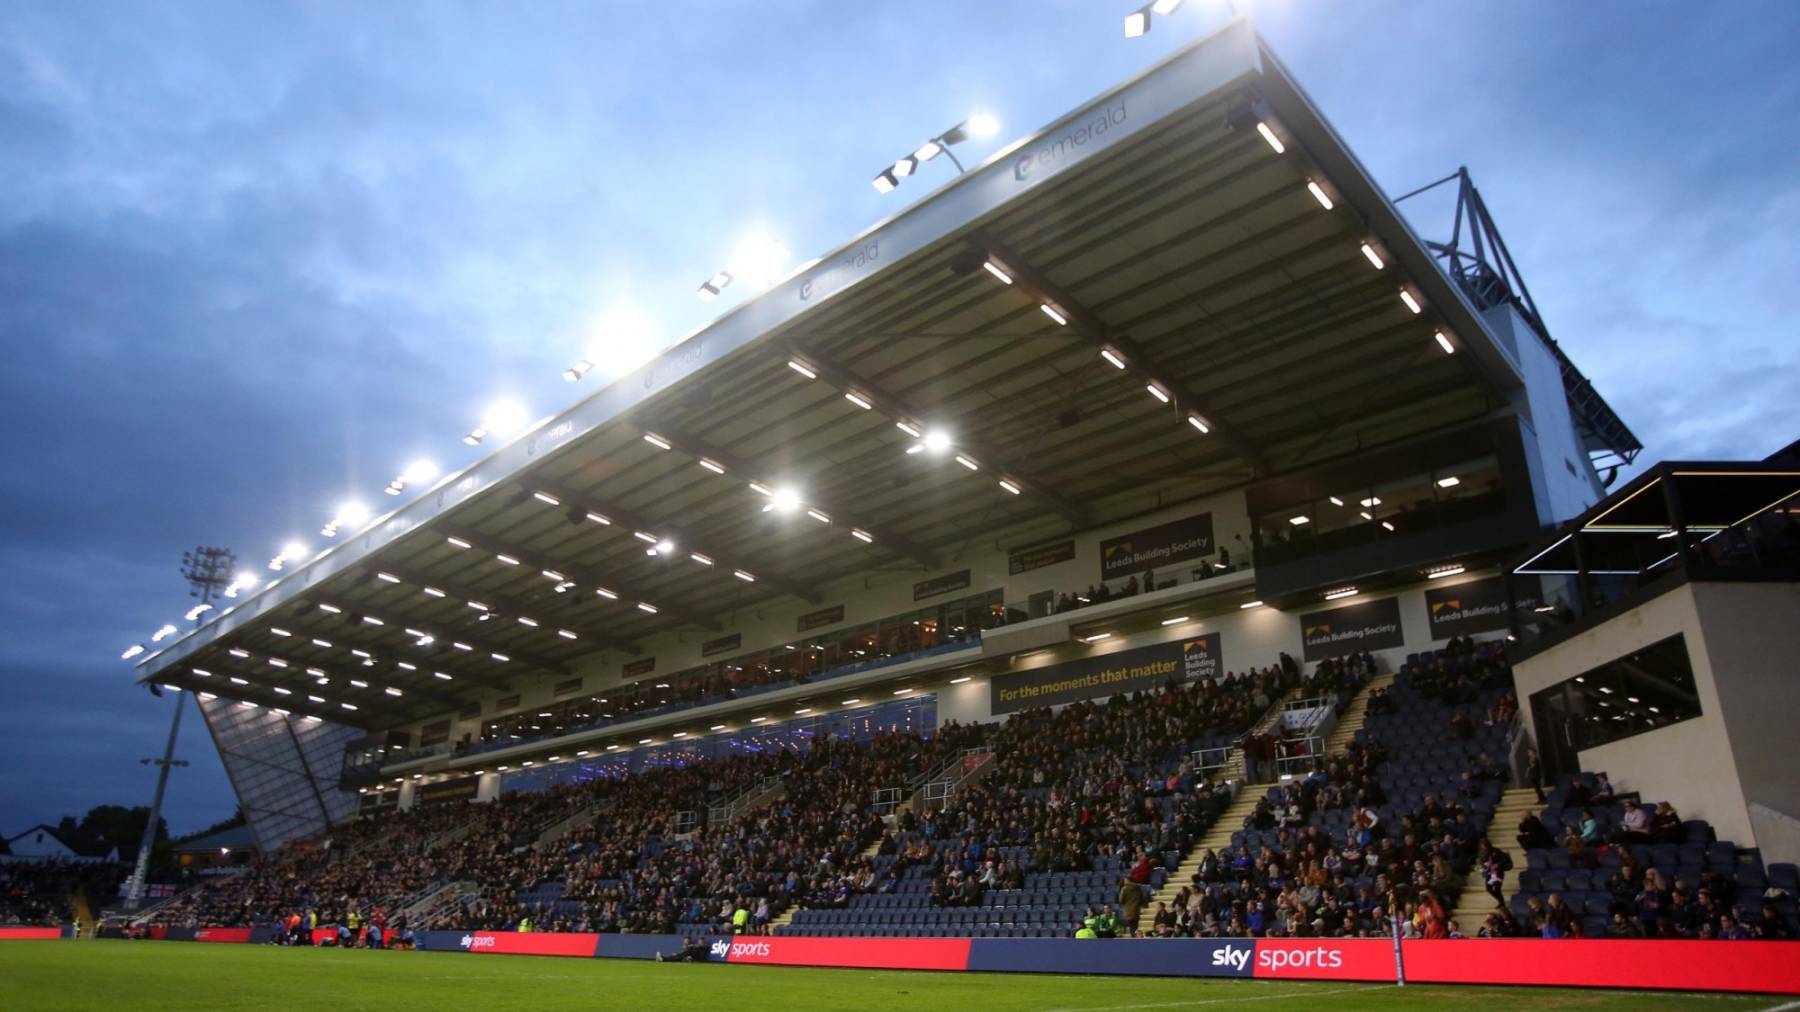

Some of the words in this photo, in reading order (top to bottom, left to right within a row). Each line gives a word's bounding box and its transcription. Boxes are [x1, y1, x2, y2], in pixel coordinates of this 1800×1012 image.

[1037, 99, 1127, 165] emerald
[1106, 556, 1133, 570] Leeds
[1134, 546, 1171, 562] Building
[1171, 537, 1208, 553] Society
[1434, 611, 1461, 623] Leeds
[1462, 603, 1500, 618] Building
[1306, 635, 1330, 646] Leeds
[1331, 629, 1364, 642] Building
[1364, 623, 1396, 636] Society
[1184, 651, 1207, 661] Leeds
[1184, 658, 1216, 670] Building
[1000, 688, 1019, 702] For
[1020, 684, 1040, 698] the
[1041, 674, 1099, 694] moments
[1100, 667, 1129, 683] that
[1131, 660, 1178, 678] matter
[1185, 668, 1216, 679] Society
[710, 940, 731, 958] sky
[731, 942, 770, 958] sports
[1212, 944, 1252, 971] sky
[1258, 947, 1342, 971] sports
